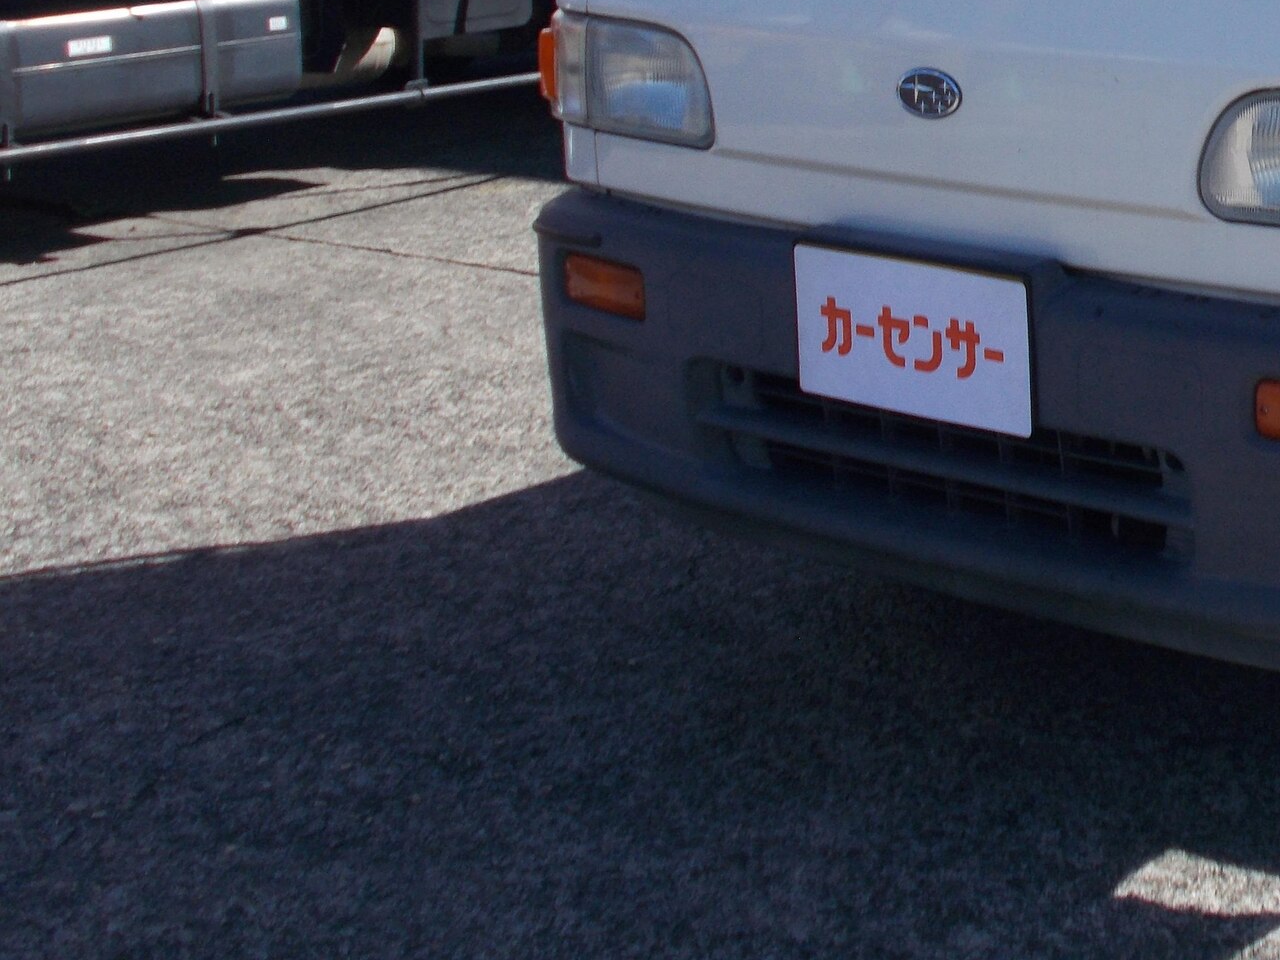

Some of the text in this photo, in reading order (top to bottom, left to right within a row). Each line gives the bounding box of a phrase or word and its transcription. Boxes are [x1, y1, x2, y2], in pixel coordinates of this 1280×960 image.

[820, 296, 1004, 378] カーセンサー
